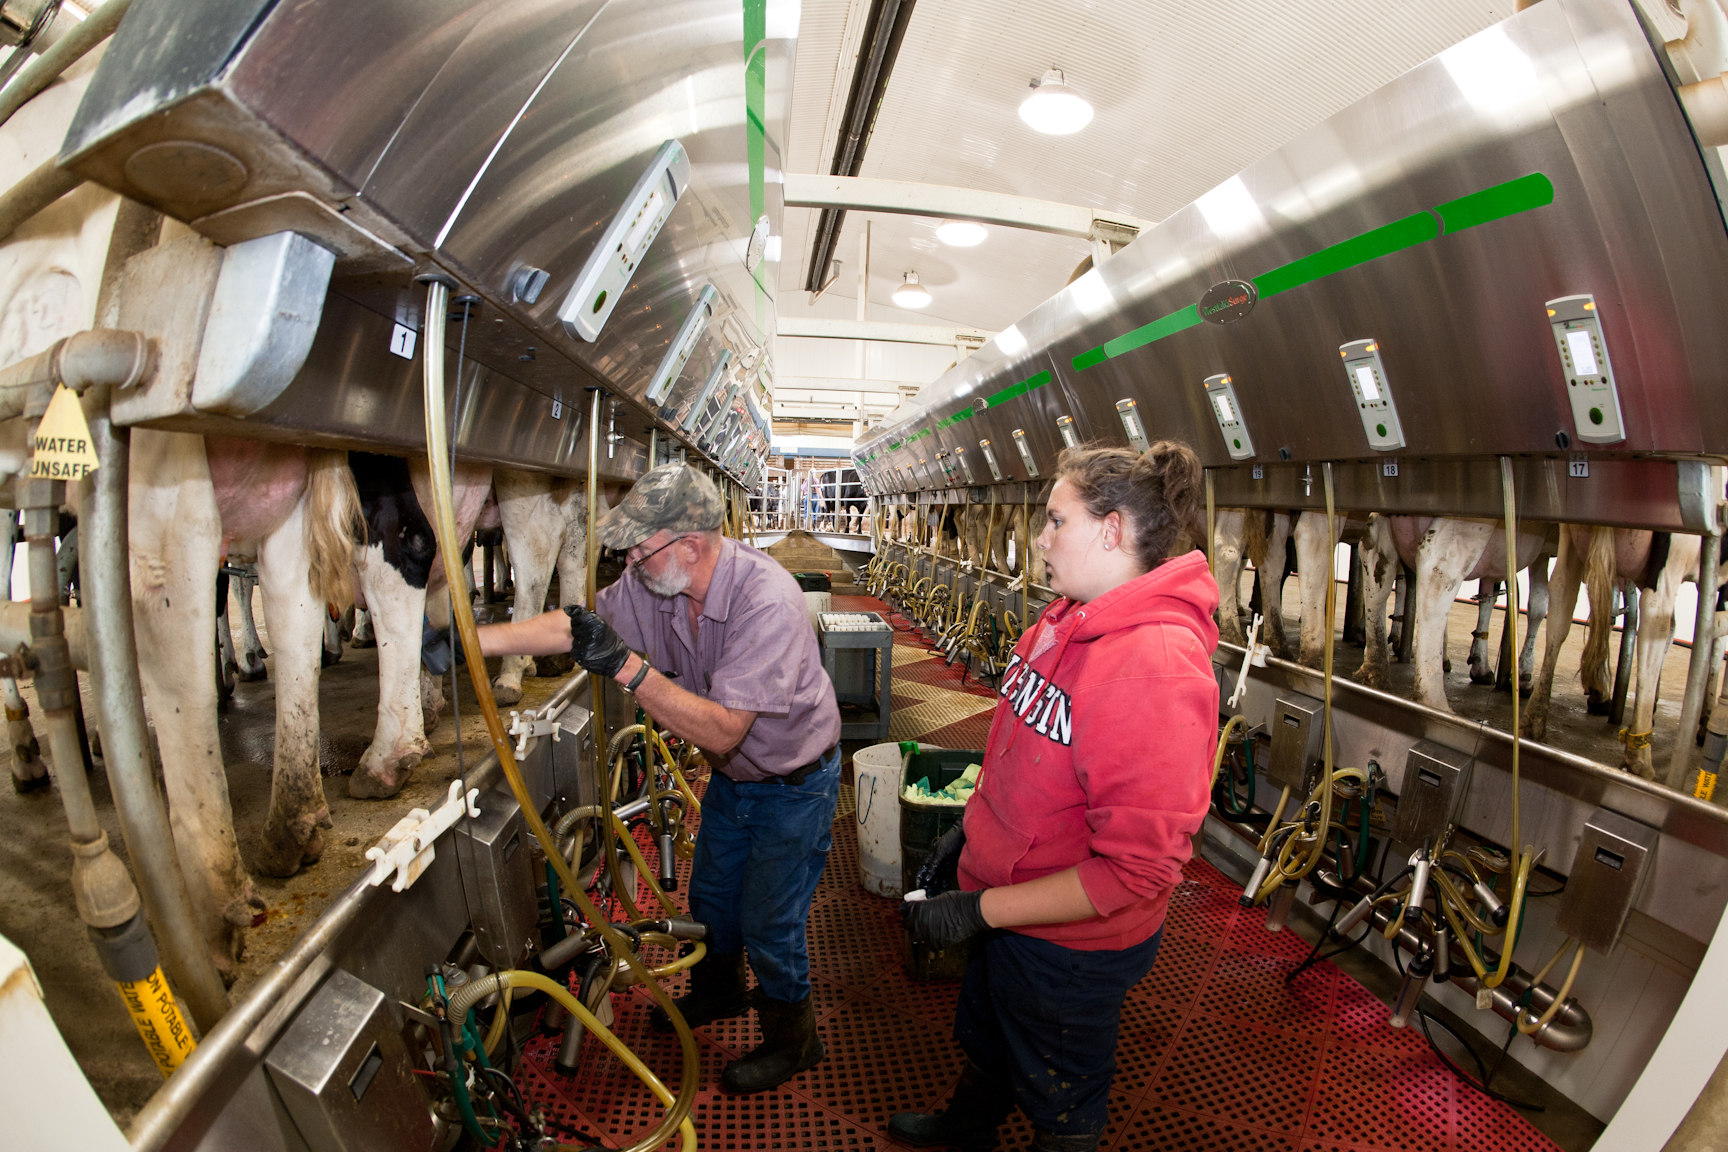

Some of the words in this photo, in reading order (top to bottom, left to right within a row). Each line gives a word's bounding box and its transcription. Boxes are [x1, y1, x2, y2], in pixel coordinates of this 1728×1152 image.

[400, 331, 408, 353] 1
[554, 403, 560, 417] 2
[35, 436, 87, 455] WATER
[1254, 470, 1262, 479] 19
[1386, 465, 1396, 475] 18
[1573, 463, 1585, 475] 17
[1703, 771, 1713, 788] WATE
[119, 981, 146, 1013] WATE
[146, 971, 162, 994] ON
[156, 992, 189, 1050] POTABLE
[137, 1018, 175, 1068] POTABLE
